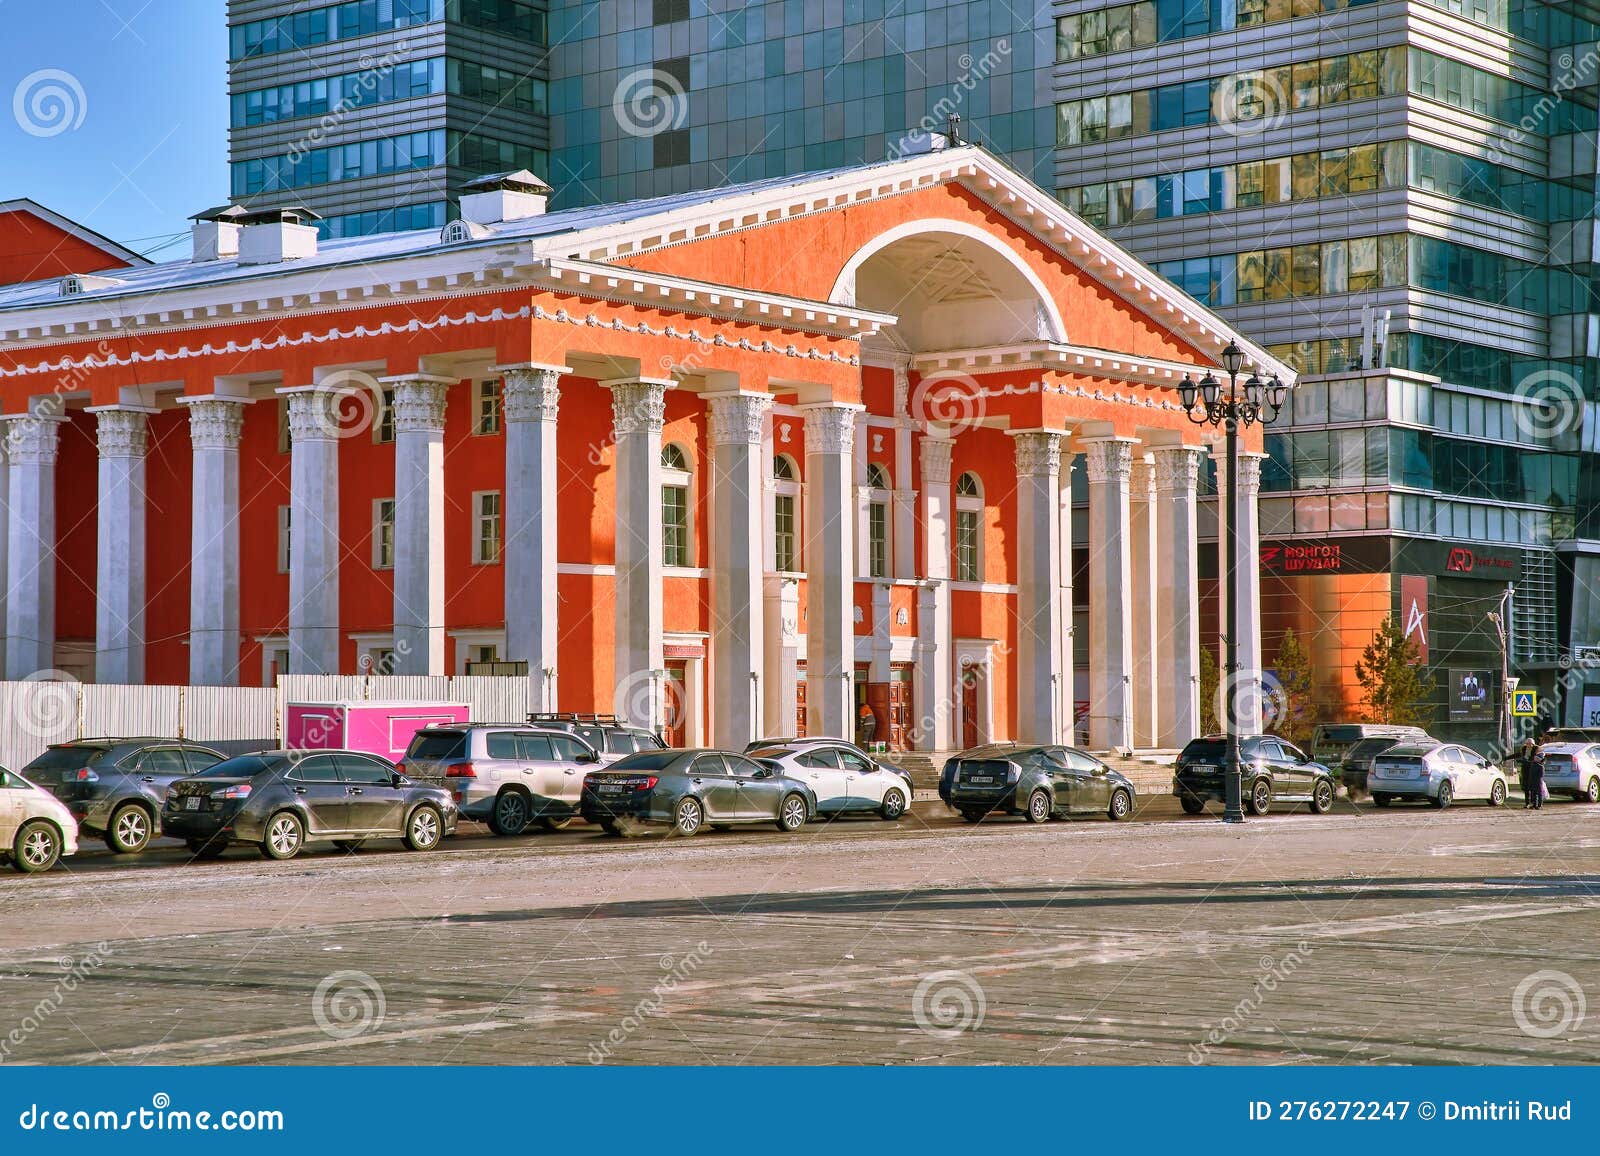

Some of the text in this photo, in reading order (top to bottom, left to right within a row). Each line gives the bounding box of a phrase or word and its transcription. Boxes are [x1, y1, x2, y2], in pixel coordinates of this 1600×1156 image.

[1284, 544, 1341, 558] МОНГОЛ
[1285, 558, 1340, 570] ШУУДАН
[1446, 547, 1474, 573] ARD
